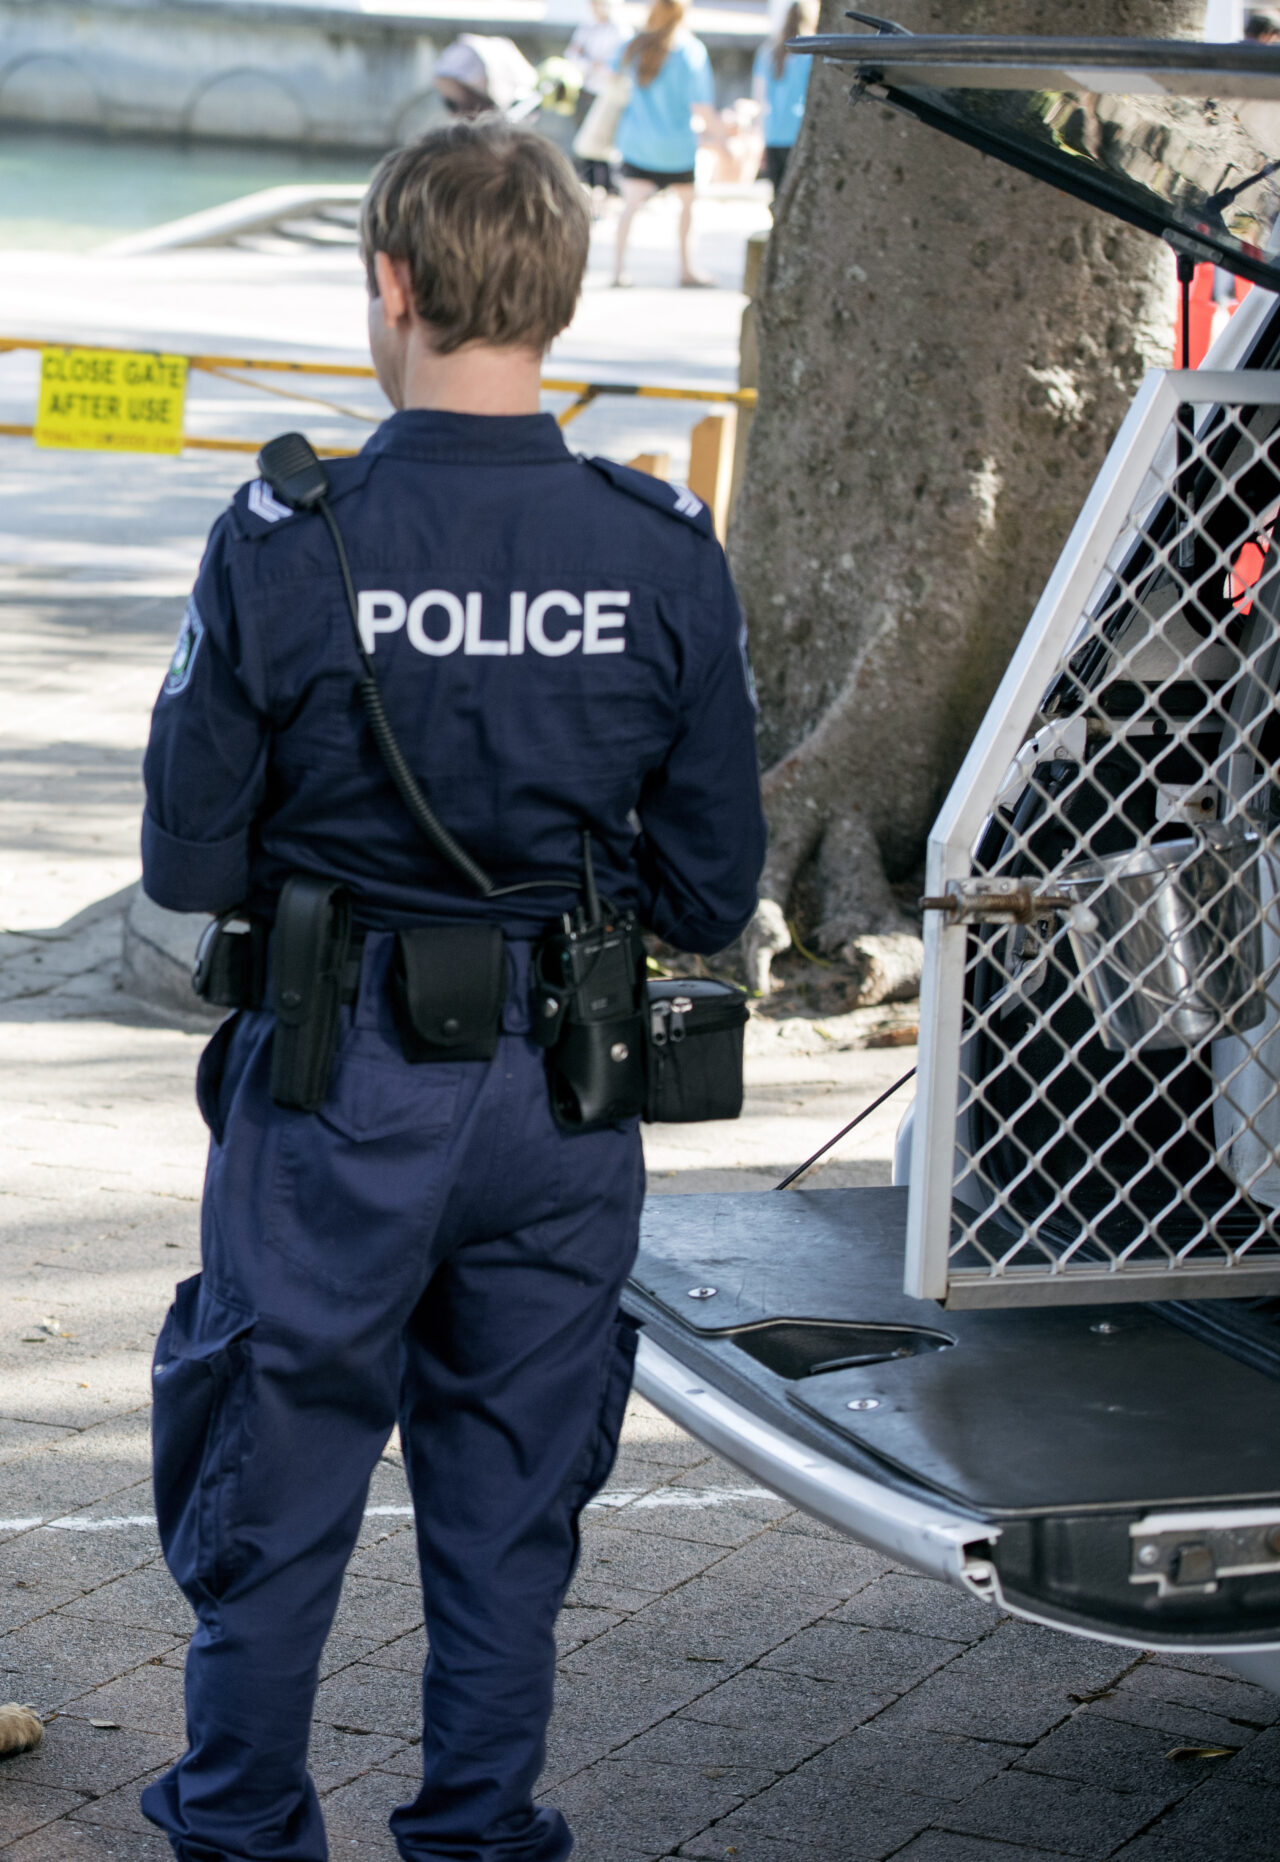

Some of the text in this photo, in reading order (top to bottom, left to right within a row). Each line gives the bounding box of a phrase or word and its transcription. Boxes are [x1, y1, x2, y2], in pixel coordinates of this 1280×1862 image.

[43, 357, 181, 389] CLOSE GATE
[48, 392, 171, 424] AFTER USE
[357, 589, 631, 657] POLICE
